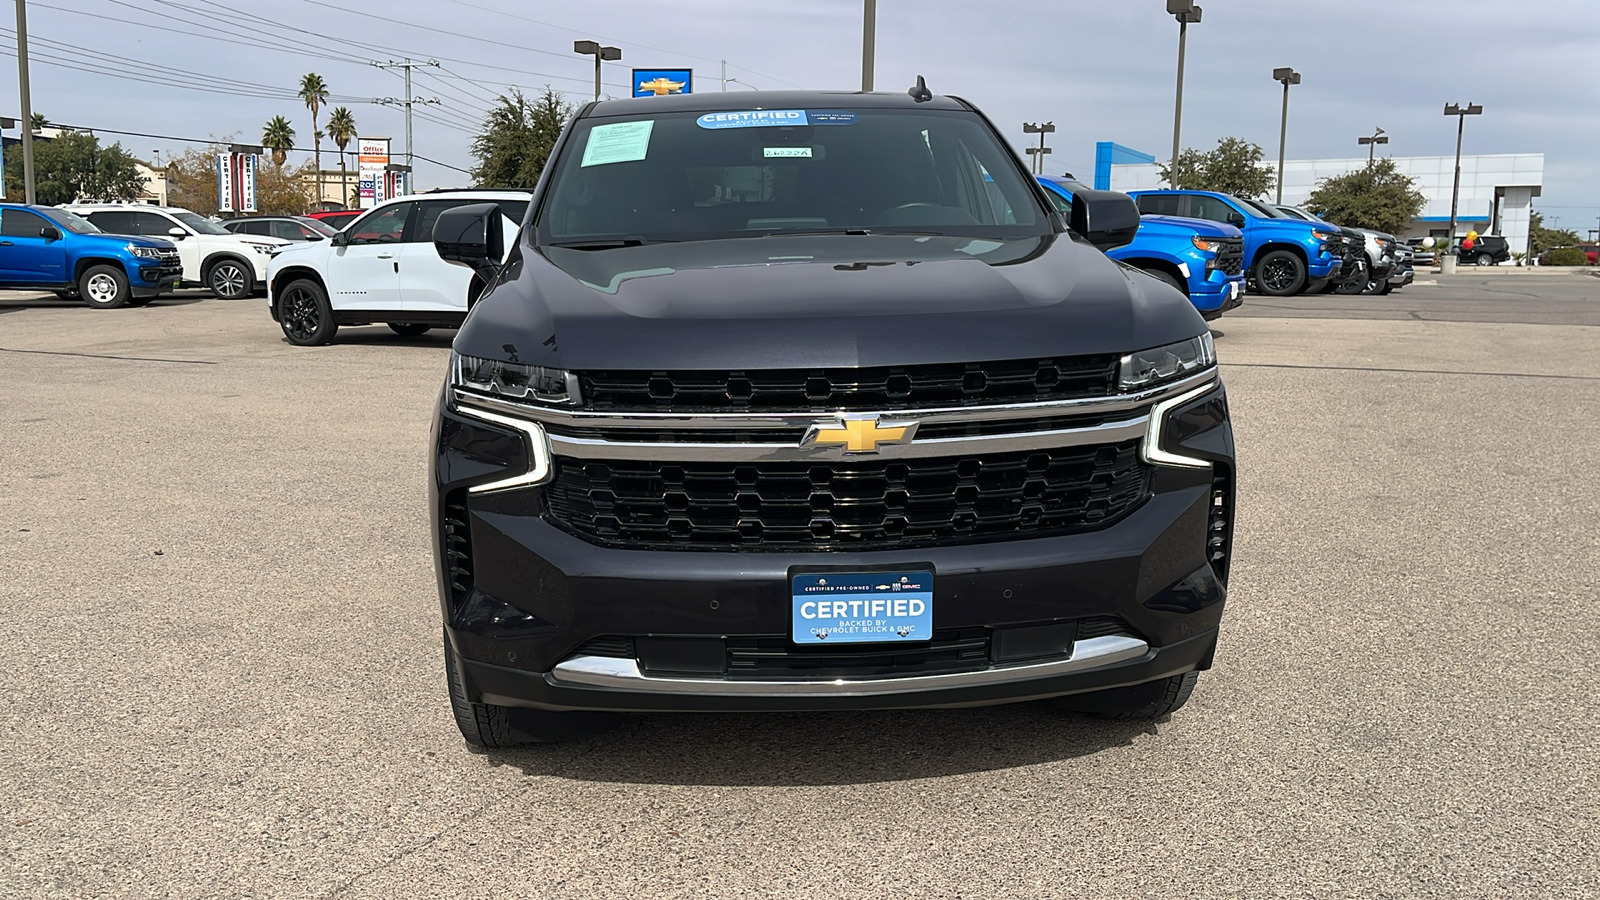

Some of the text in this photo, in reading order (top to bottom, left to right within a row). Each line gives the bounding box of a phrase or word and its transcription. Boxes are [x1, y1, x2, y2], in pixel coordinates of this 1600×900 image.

[702, 112, 800, 122] CERTIFIED
[222, 156, 230, 208] CERTIFIED
[800, 599, 926, 619] CERTIFIED
